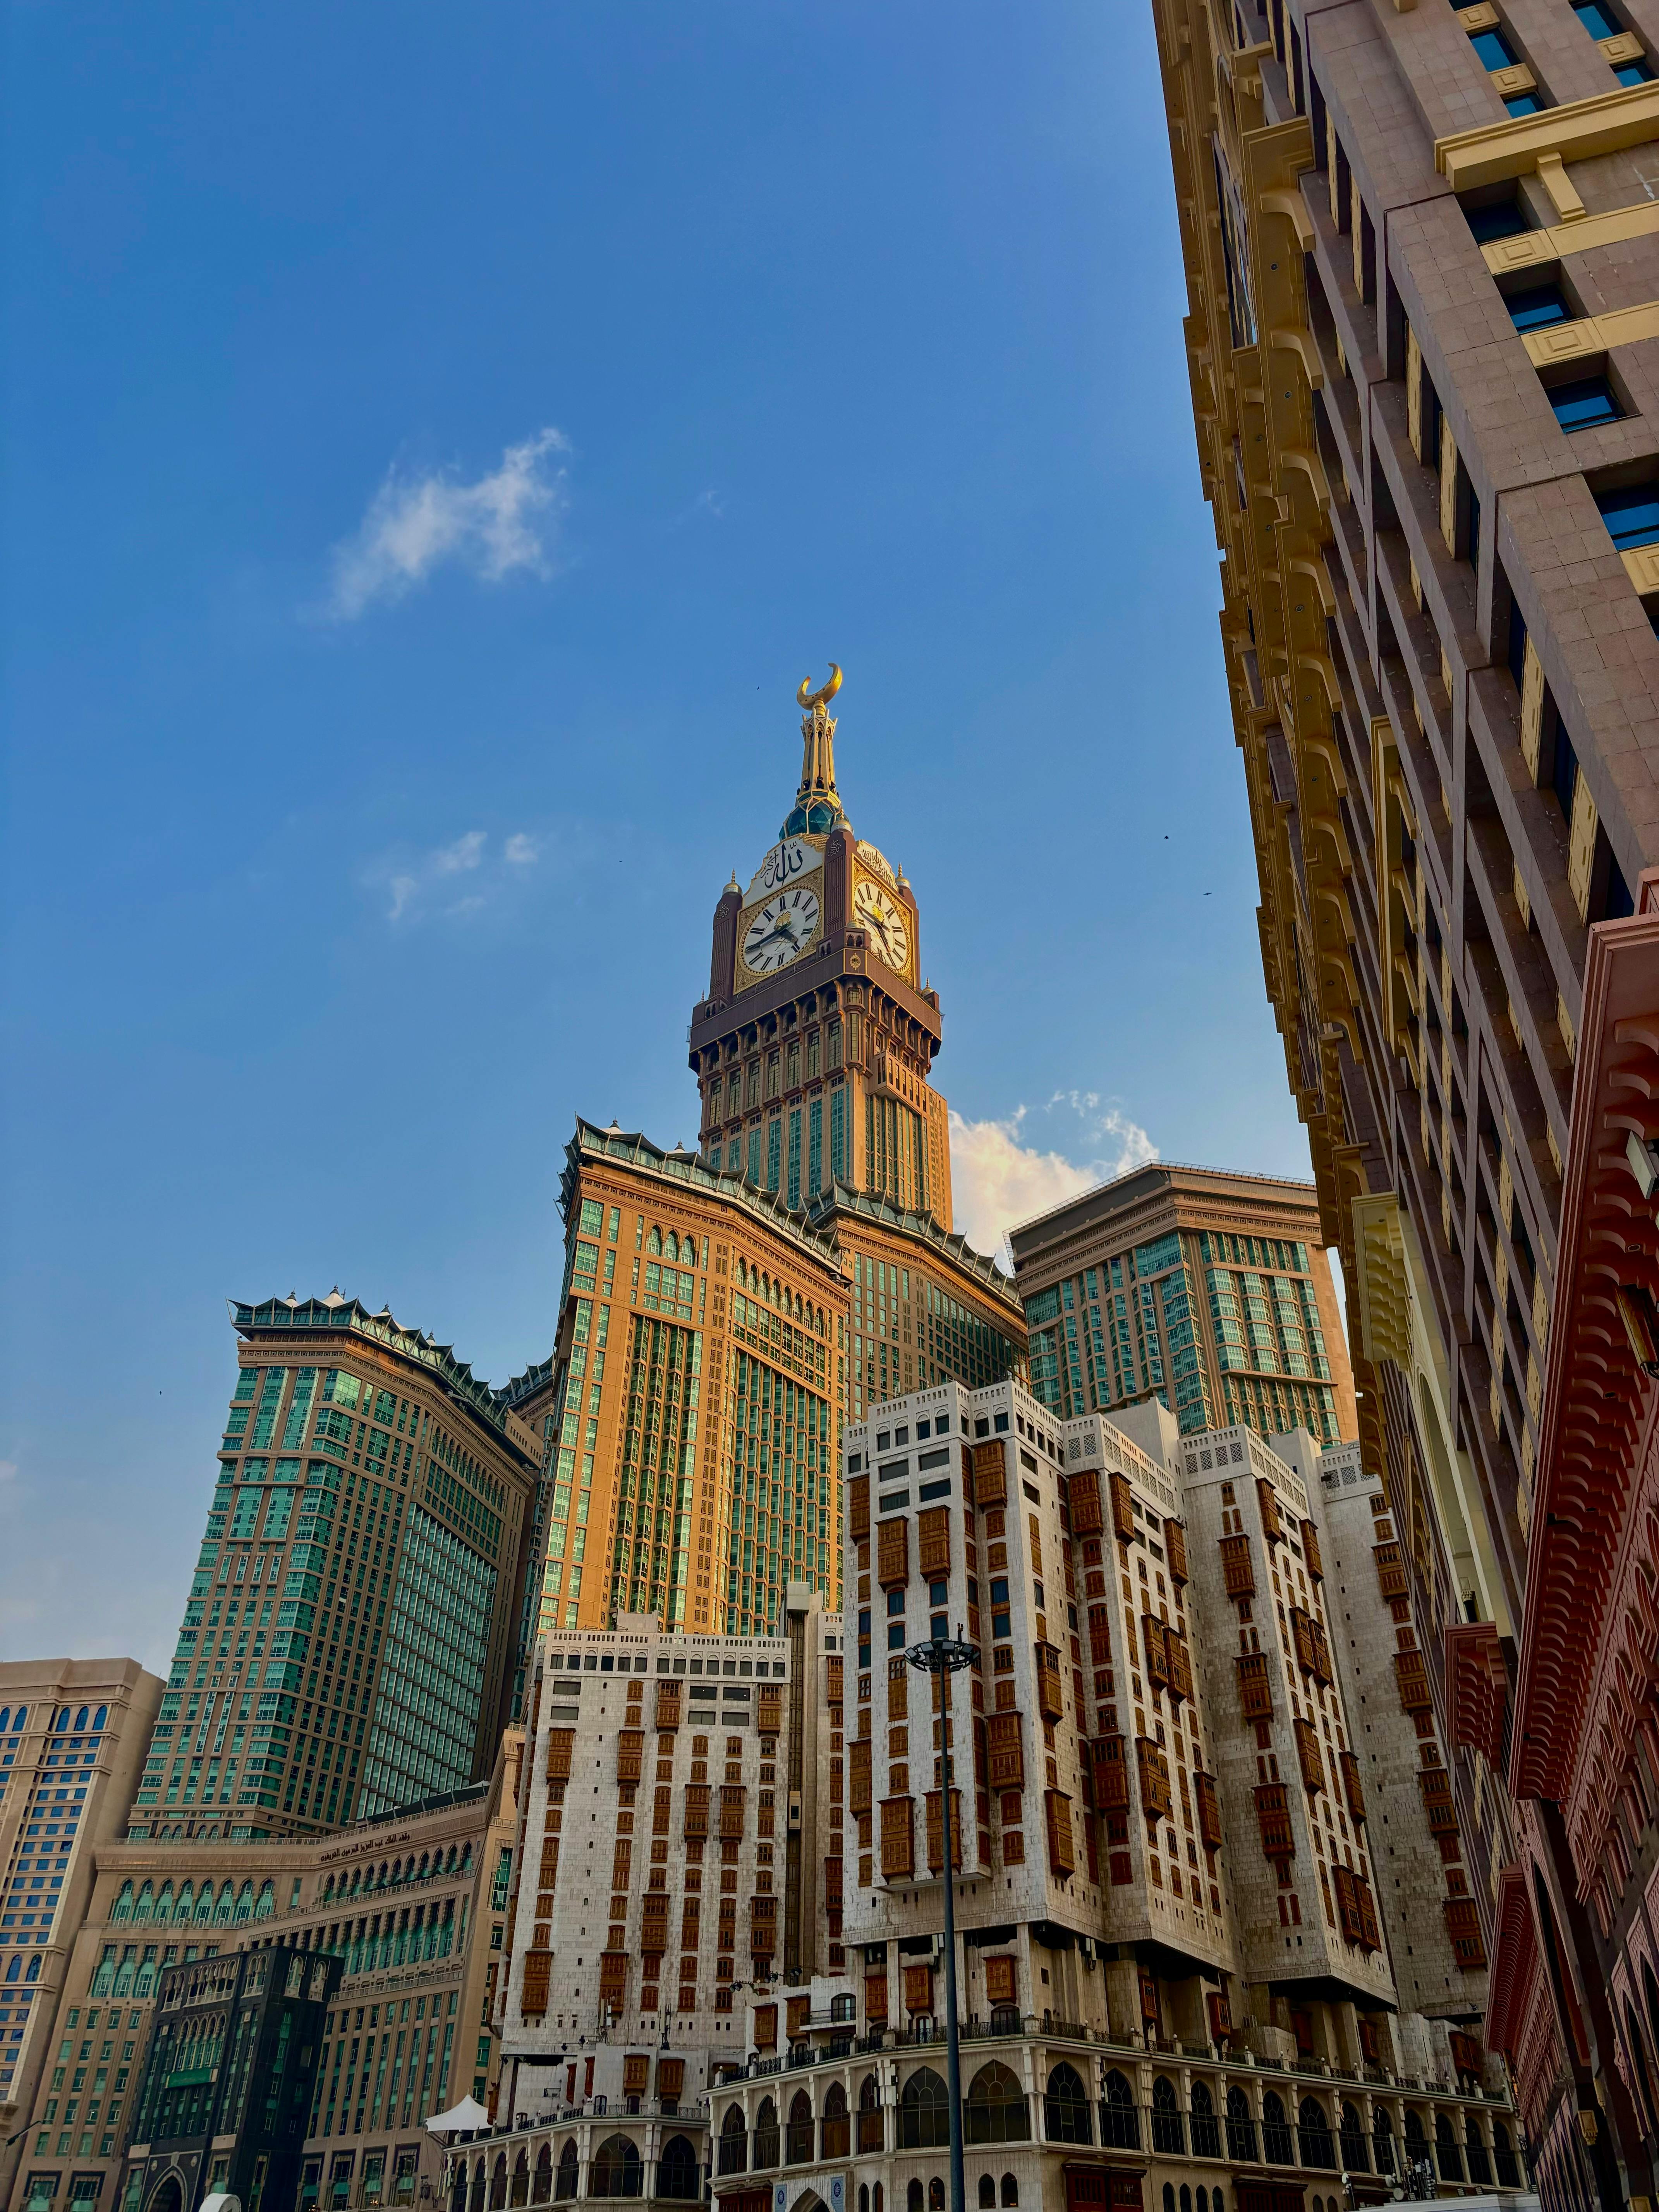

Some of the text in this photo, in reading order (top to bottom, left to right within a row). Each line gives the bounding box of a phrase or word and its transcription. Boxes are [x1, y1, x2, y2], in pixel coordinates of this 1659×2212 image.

[375, 1839, 383, 1848] عبد
[385, 1834, 397, 1844] الملك
[341, 1844, 359, 1856] للحرمين
[360, 1840, 373, 1853] العزيز
[321, 1848, 340, 1862] الشريفين
